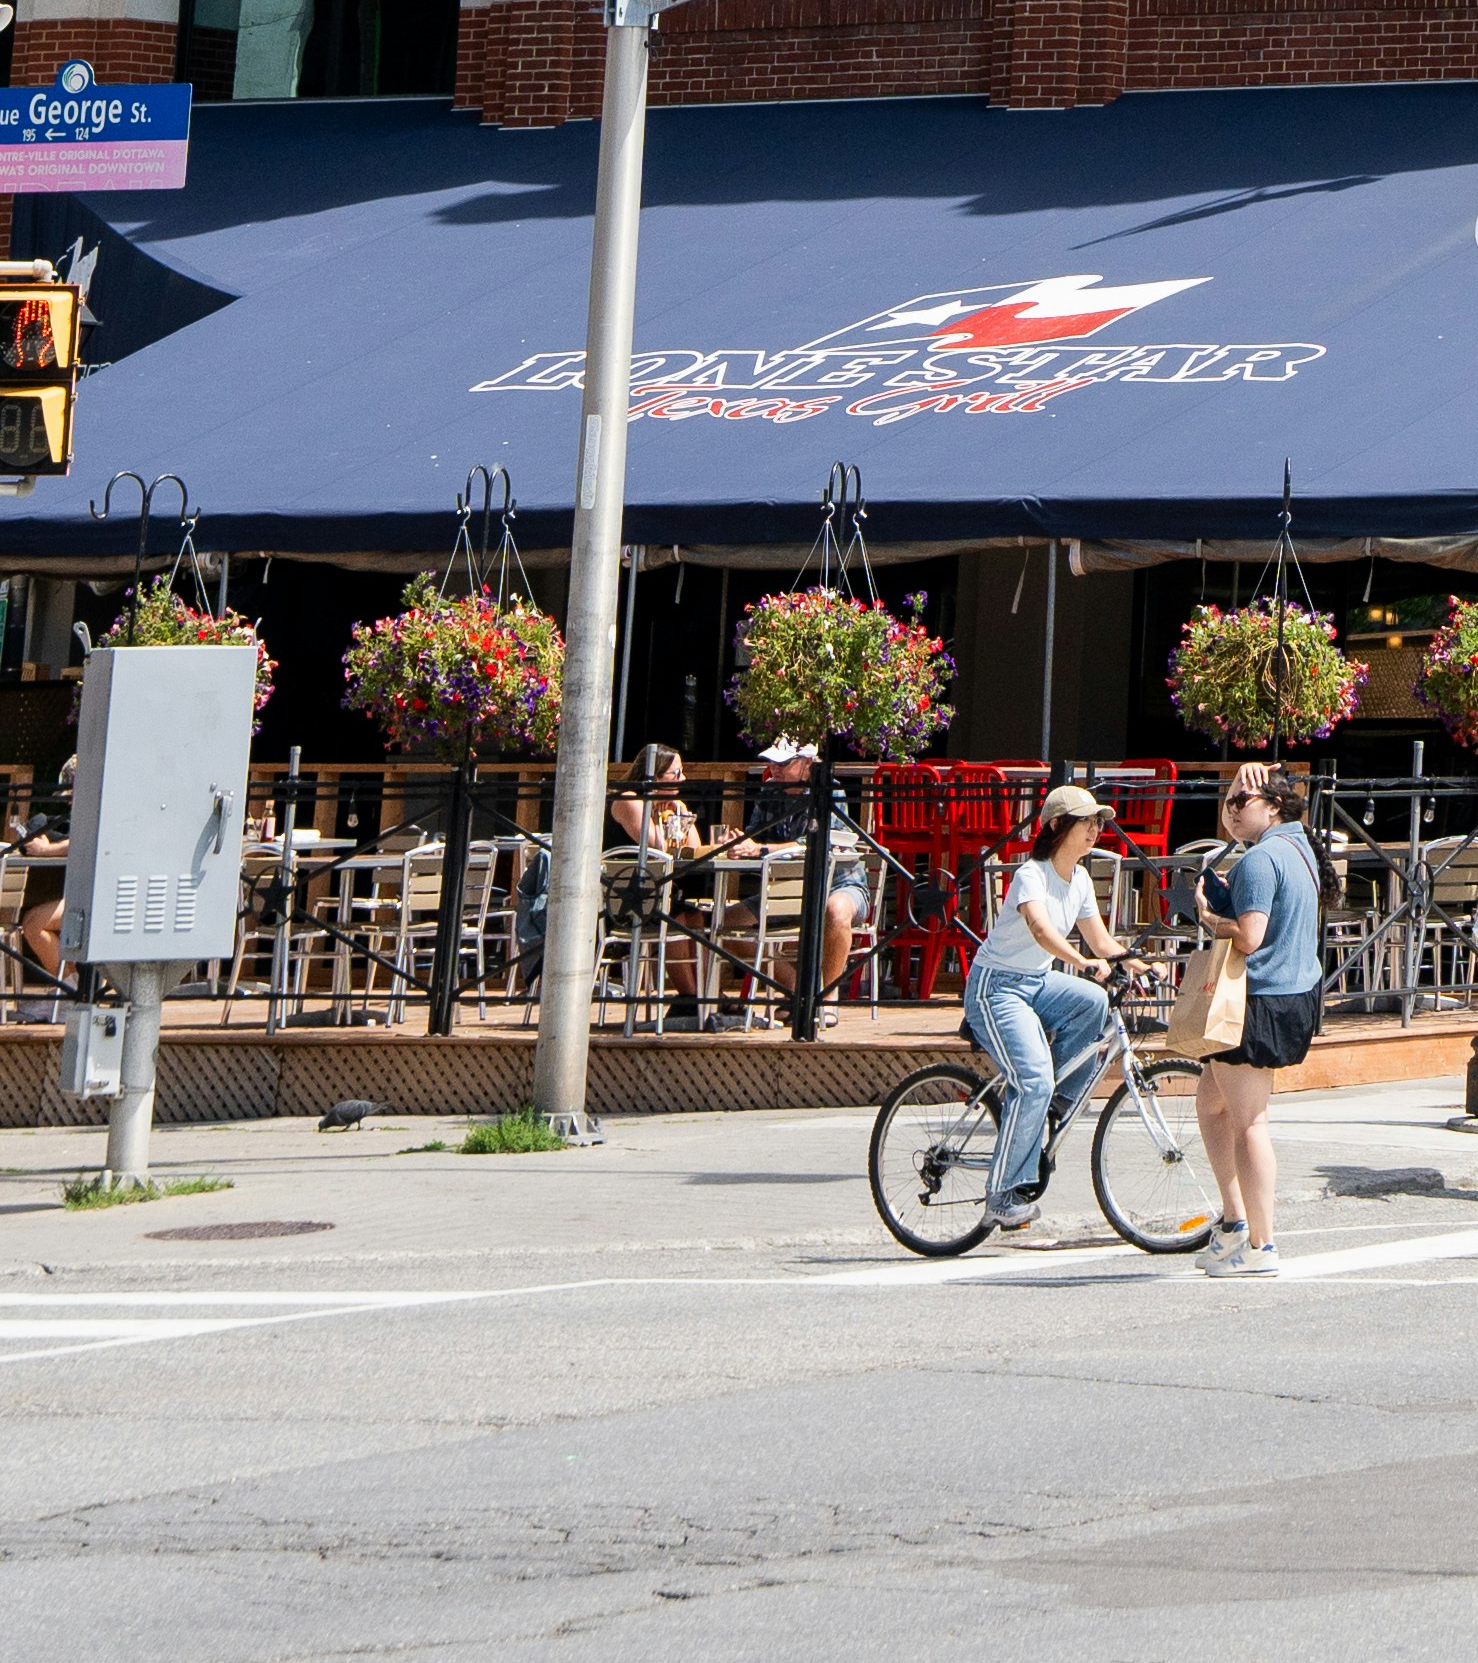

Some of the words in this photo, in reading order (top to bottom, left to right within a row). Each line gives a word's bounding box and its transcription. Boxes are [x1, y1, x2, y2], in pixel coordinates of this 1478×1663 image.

[0, 108, 19, 125] ue
[29, 93, 122, 133] George
[130, 102, 151, 123] St.
[22, 128, 37, 142] 195
[75, 127, 89, 141] 124
[0, 150, 56, 162] NTRE-VILLE
[59, 149, 110, 160] ORIGINAL
[112, 148, 165, 160] D'OTTAWA
[0, 165, 25, 176] WA'S
[28, 163, 85, 174] ORIGINAL
[88, 162, 165, 174] DOWNTOWN
[469, 350, 918, 391] LONE
[884, 343, 1327, 385] STAR
[626, 385, 842, 423] Texas
[847, 378, 1096, 425] Grill
